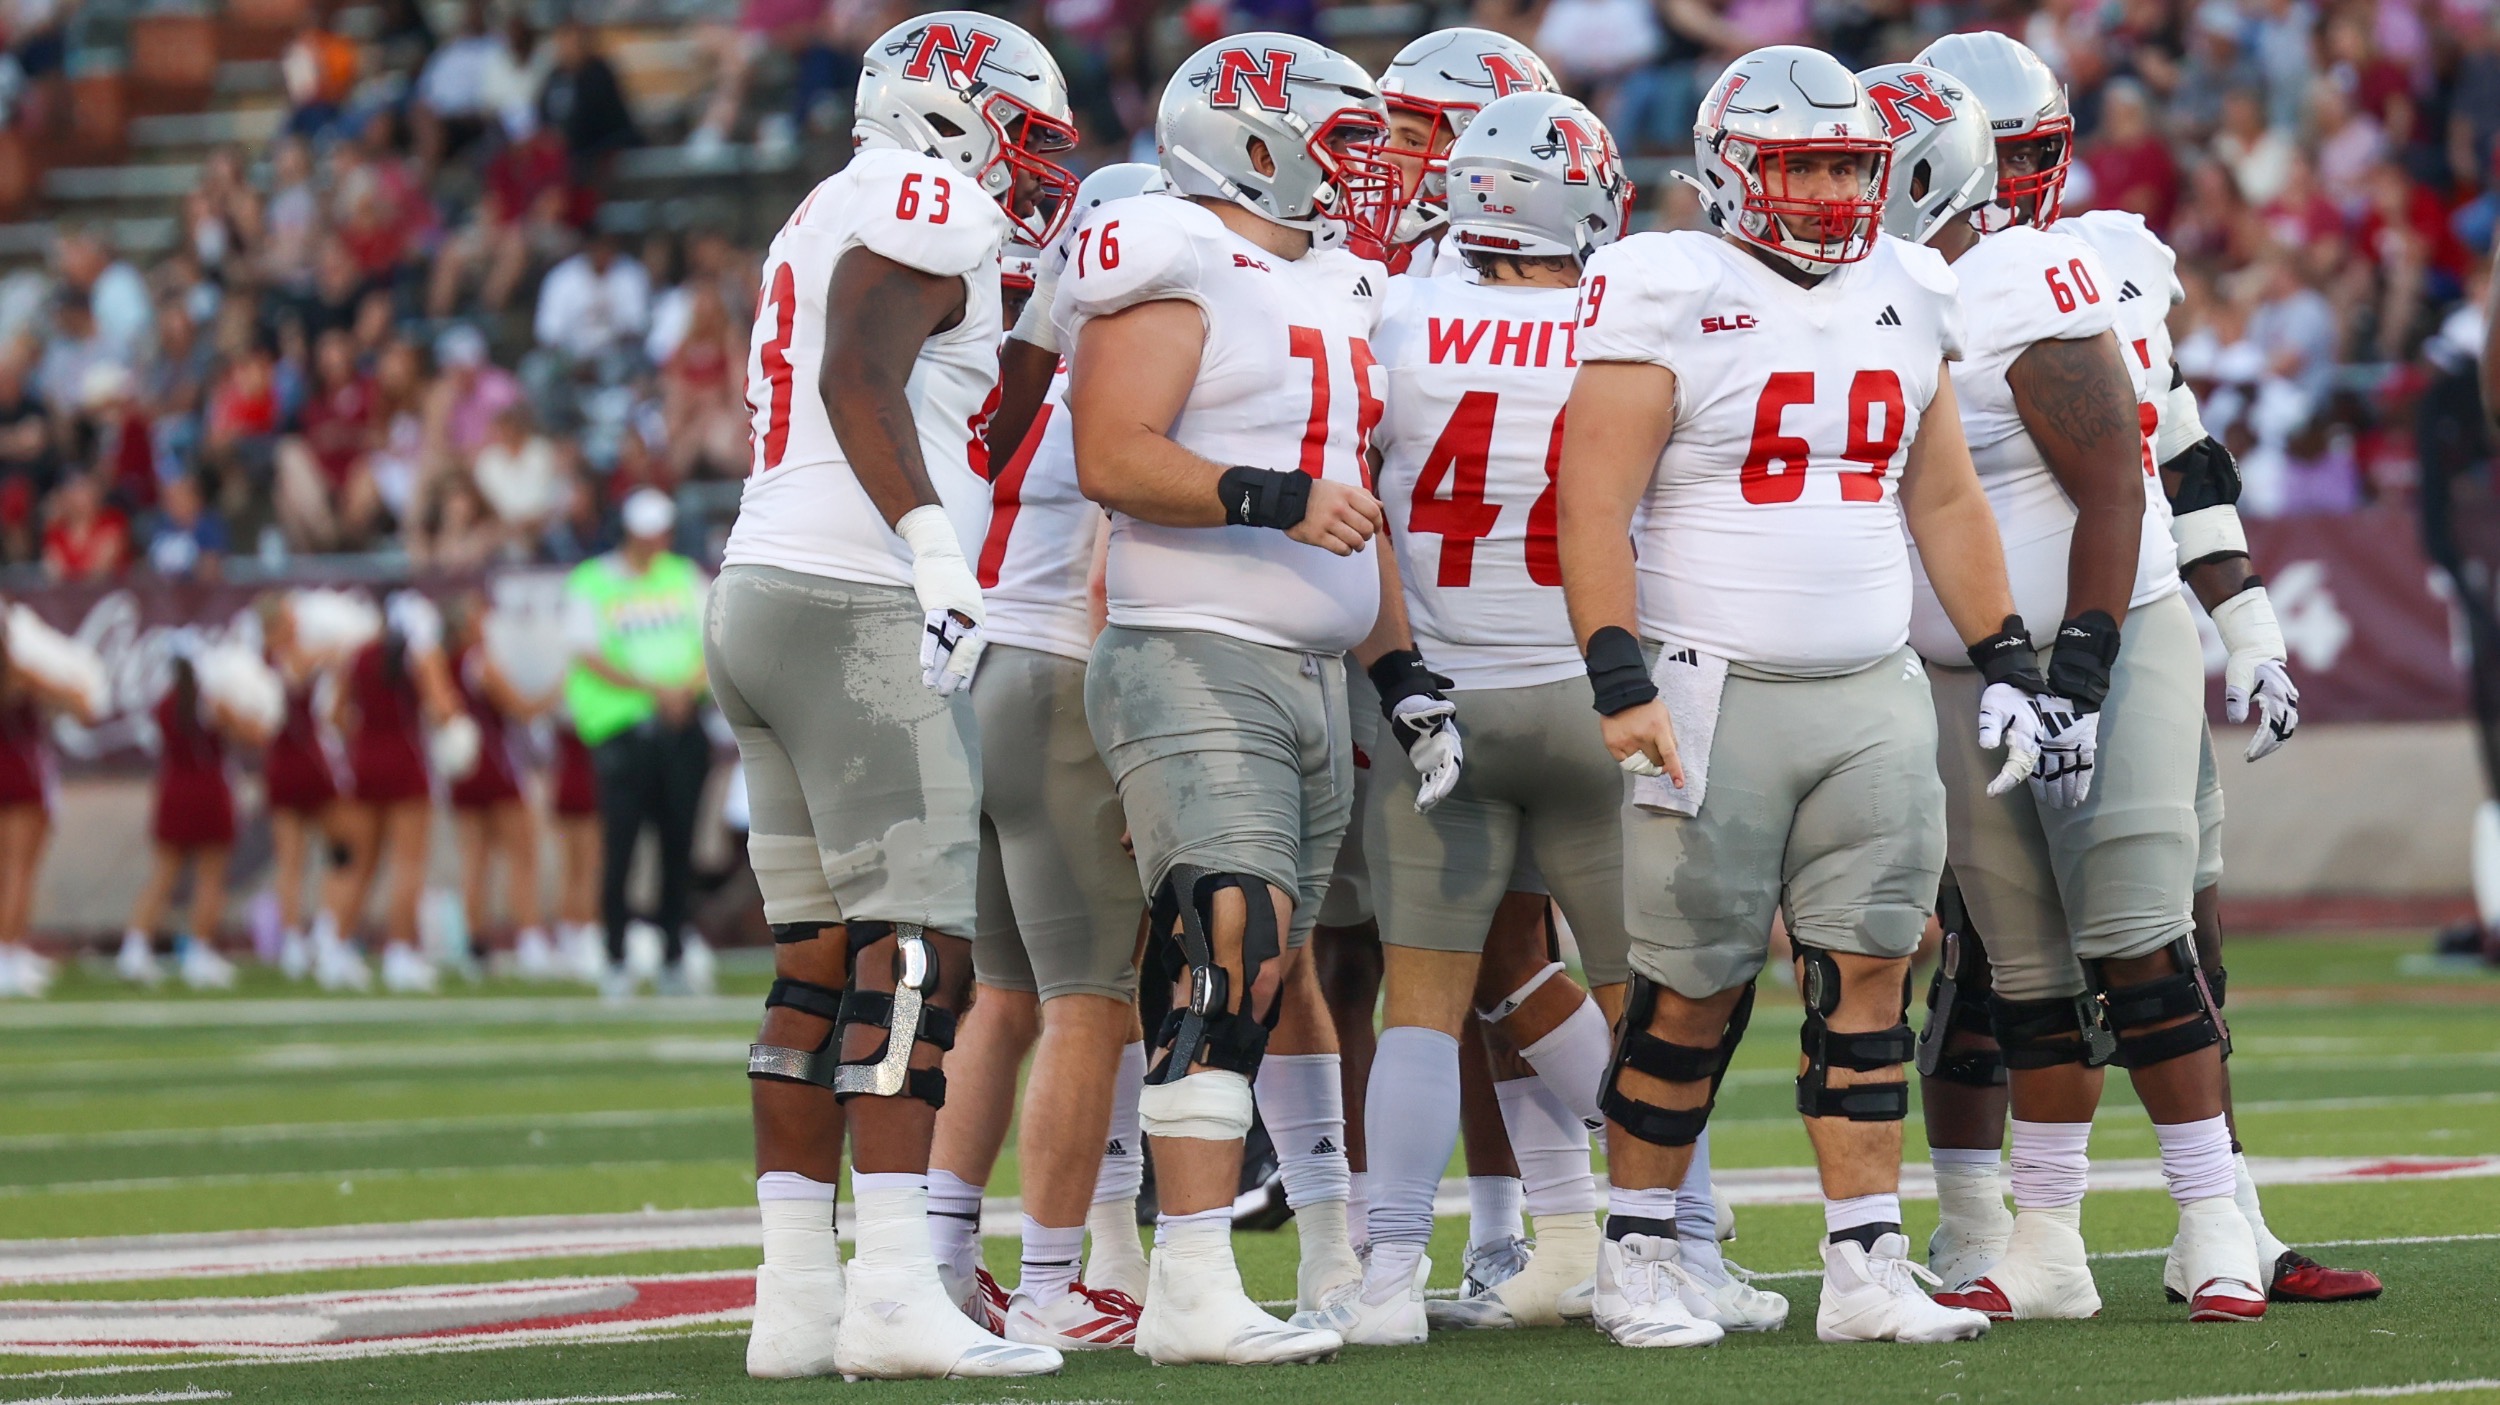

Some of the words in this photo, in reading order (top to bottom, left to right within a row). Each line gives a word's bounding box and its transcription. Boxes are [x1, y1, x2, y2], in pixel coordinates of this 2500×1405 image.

[1210, 48, 1296, 113] N
[1833, 123, 1848, 136] N
[895, 172, 951, 225] 63
[1078, 220, 1120, 279] 76
[2044, 257, 2101, 314] 60
[743, 261, 796, 480] 3
[1427, 316, 1578, 368] WHIT
[1739, 368, 1906, 505] 69
